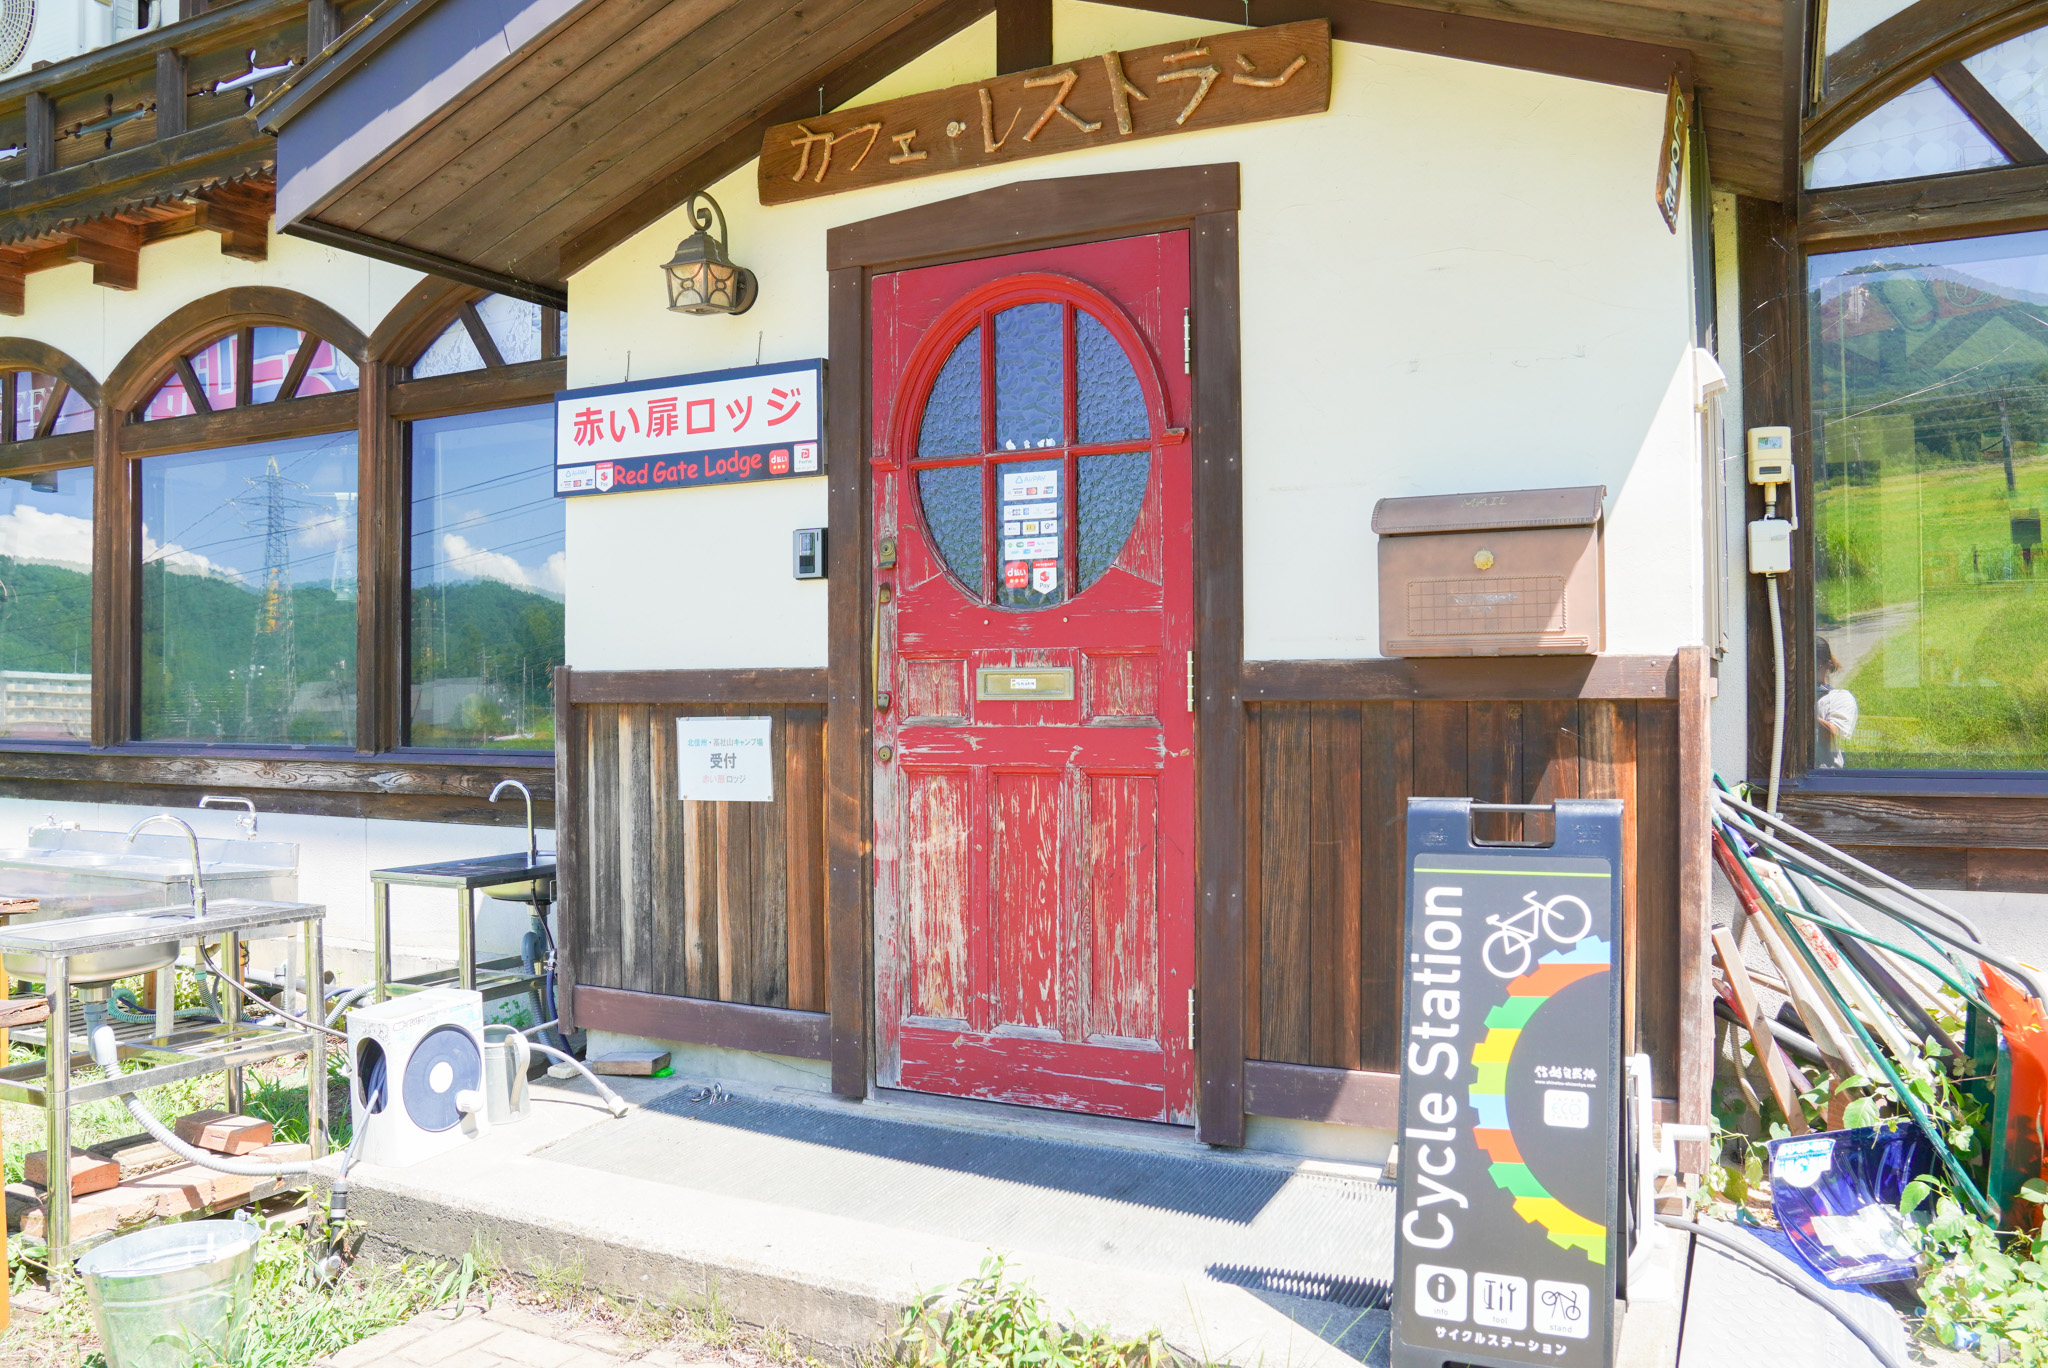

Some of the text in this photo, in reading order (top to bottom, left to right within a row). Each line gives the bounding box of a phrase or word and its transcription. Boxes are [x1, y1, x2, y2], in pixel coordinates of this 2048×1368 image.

[790, 38, 1307, 184] カフェ・レストラン
[572, 387, 802, 447] 赤い扉ロッジ
[614, 449, 762, 486] Red Gate Lodge
[1460, 496, 1509, 508] MAIL
[710, 752, 737, 769] 受付
[1408, 886, 1464, 1078] Station
[1402, 1088, 1469, 1250] Cycle
[1433, 1307, 1449, 1316] info
[1492, 1315, 1508, 1325] tool
[1434, 1325, 1568, 1356] サイクルステーション
[1549, 1323, 1573, 1334] stand
